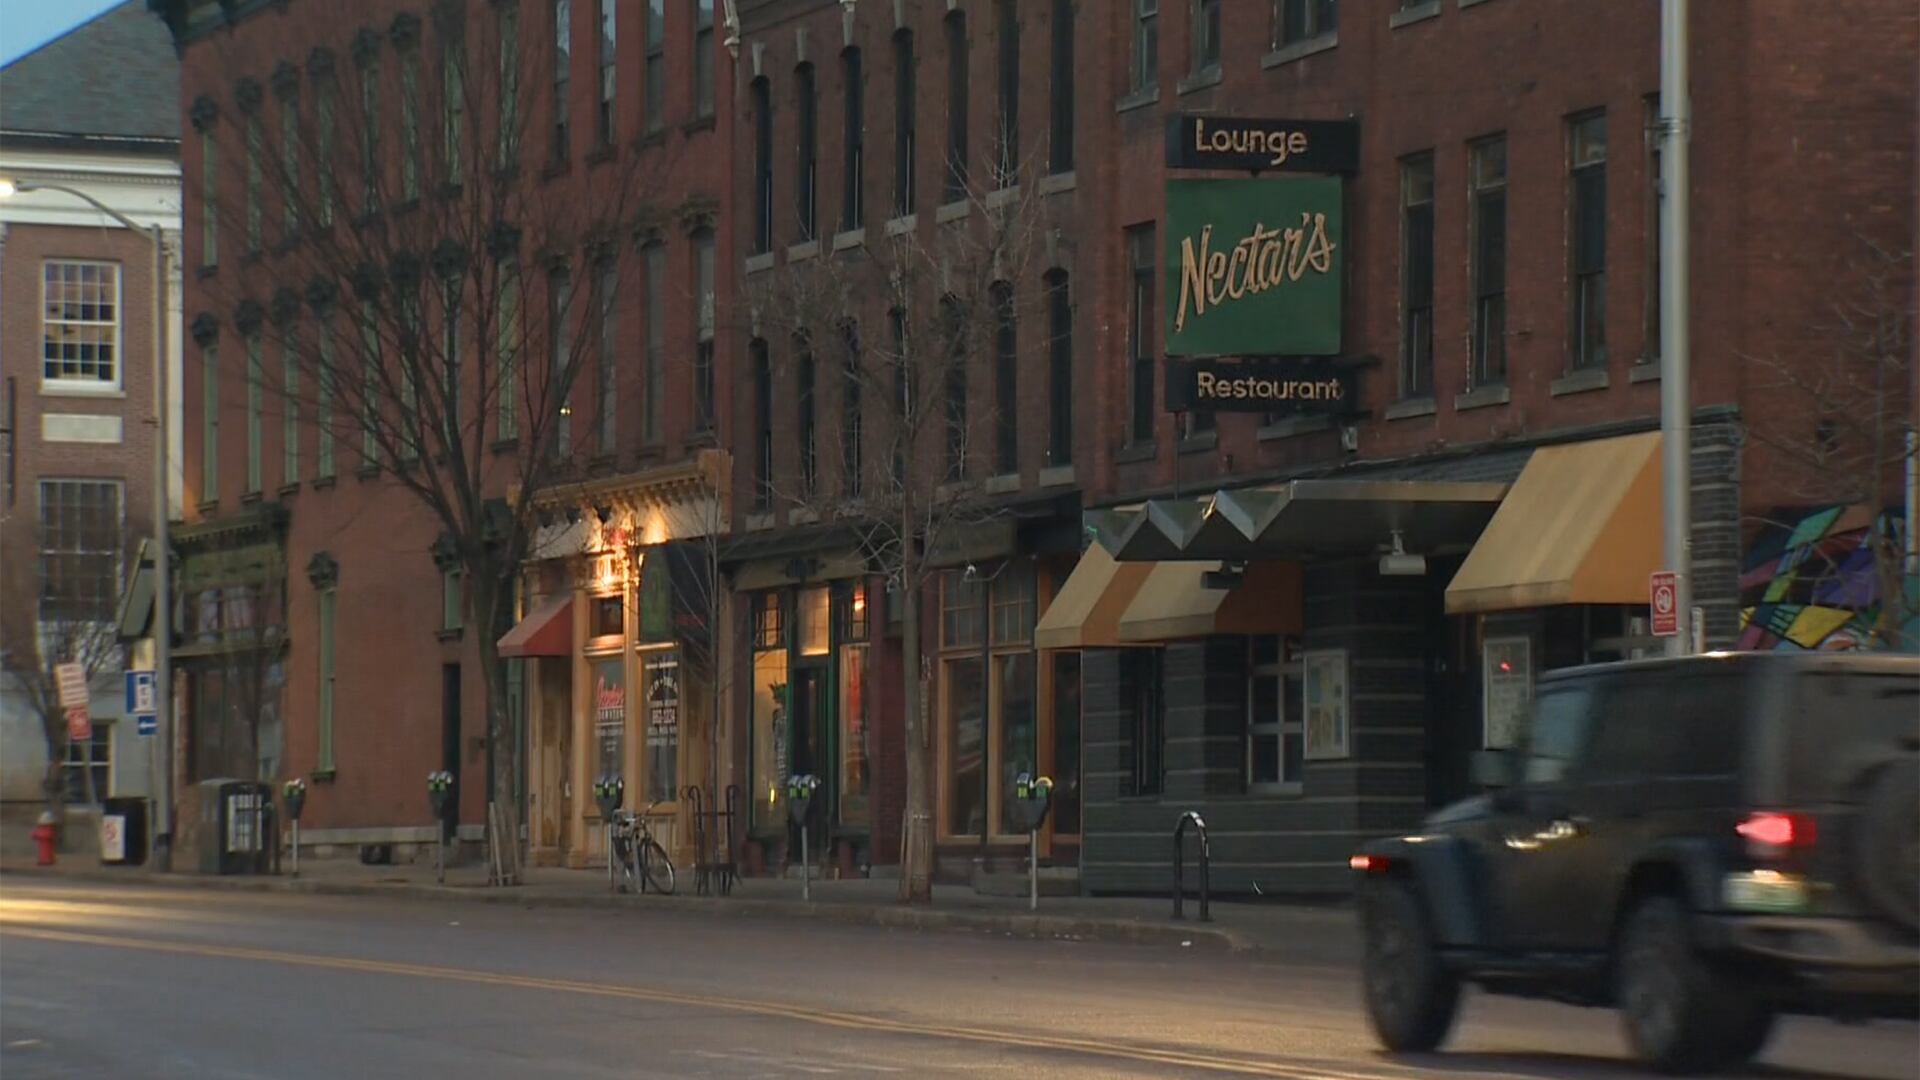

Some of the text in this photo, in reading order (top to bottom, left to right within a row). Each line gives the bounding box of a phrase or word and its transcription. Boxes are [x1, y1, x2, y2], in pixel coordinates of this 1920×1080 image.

[1195, 118, 1308, 166] Lounge
[1175, 212, 1337, 333] Nectar's
[1197, 371, 1343, 401] Restaurant
